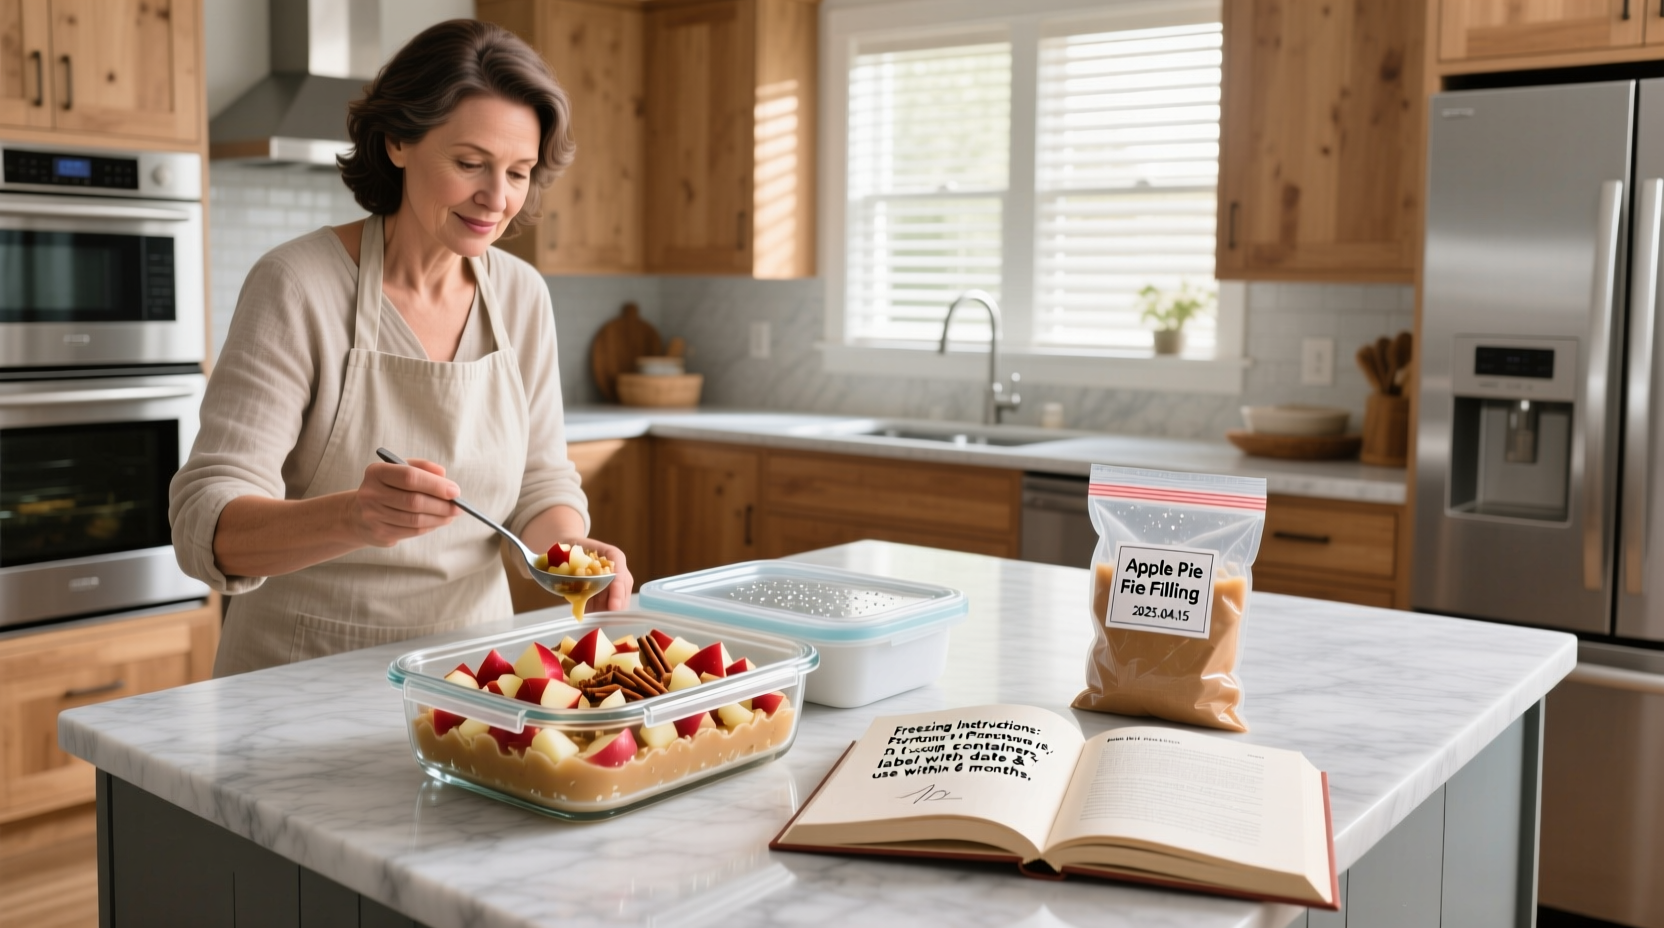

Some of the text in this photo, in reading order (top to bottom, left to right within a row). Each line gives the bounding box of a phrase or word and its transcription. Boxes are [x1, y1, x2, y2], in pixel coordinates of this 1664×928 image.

[1125, 558, 1203, 578] Apple Pie
[1120, 578, 1199, 605] Fie Filling
[1132, 605, 1190, 621] 2025.04.15
[894, 721, 952, 736] Freezing
[877, 754, 921, 769] label
[969, 751, 1007, 763] date
[872, 770, 898, 779] use
[954, 762, 964, 773] 6
